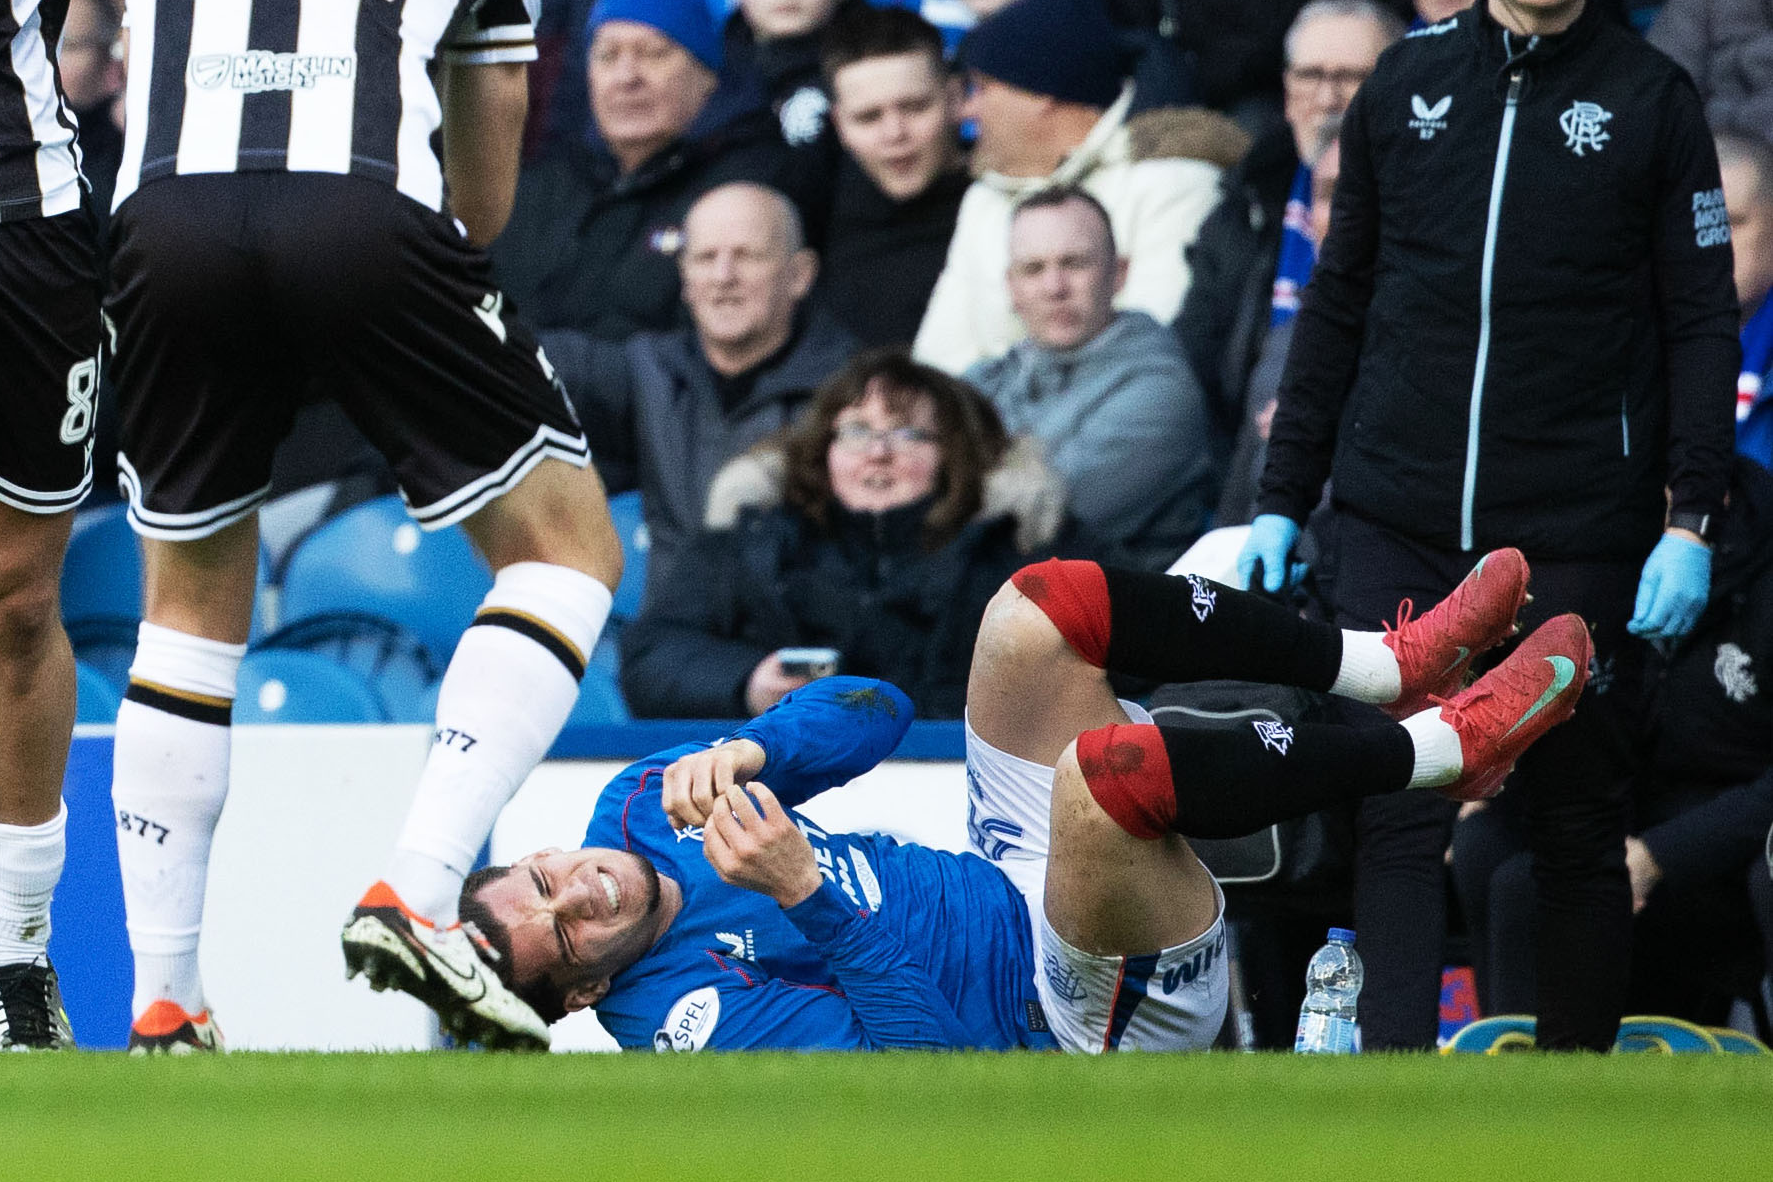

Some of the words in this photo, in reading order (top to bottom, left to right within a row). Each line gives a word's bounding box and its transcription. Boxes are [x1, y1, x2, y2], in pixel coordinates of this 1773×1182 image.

[1696, 224, 1732, 248] GRO
[59, 357, 96, 445] 8
[674, 1001, 707, 1045] SPFL
